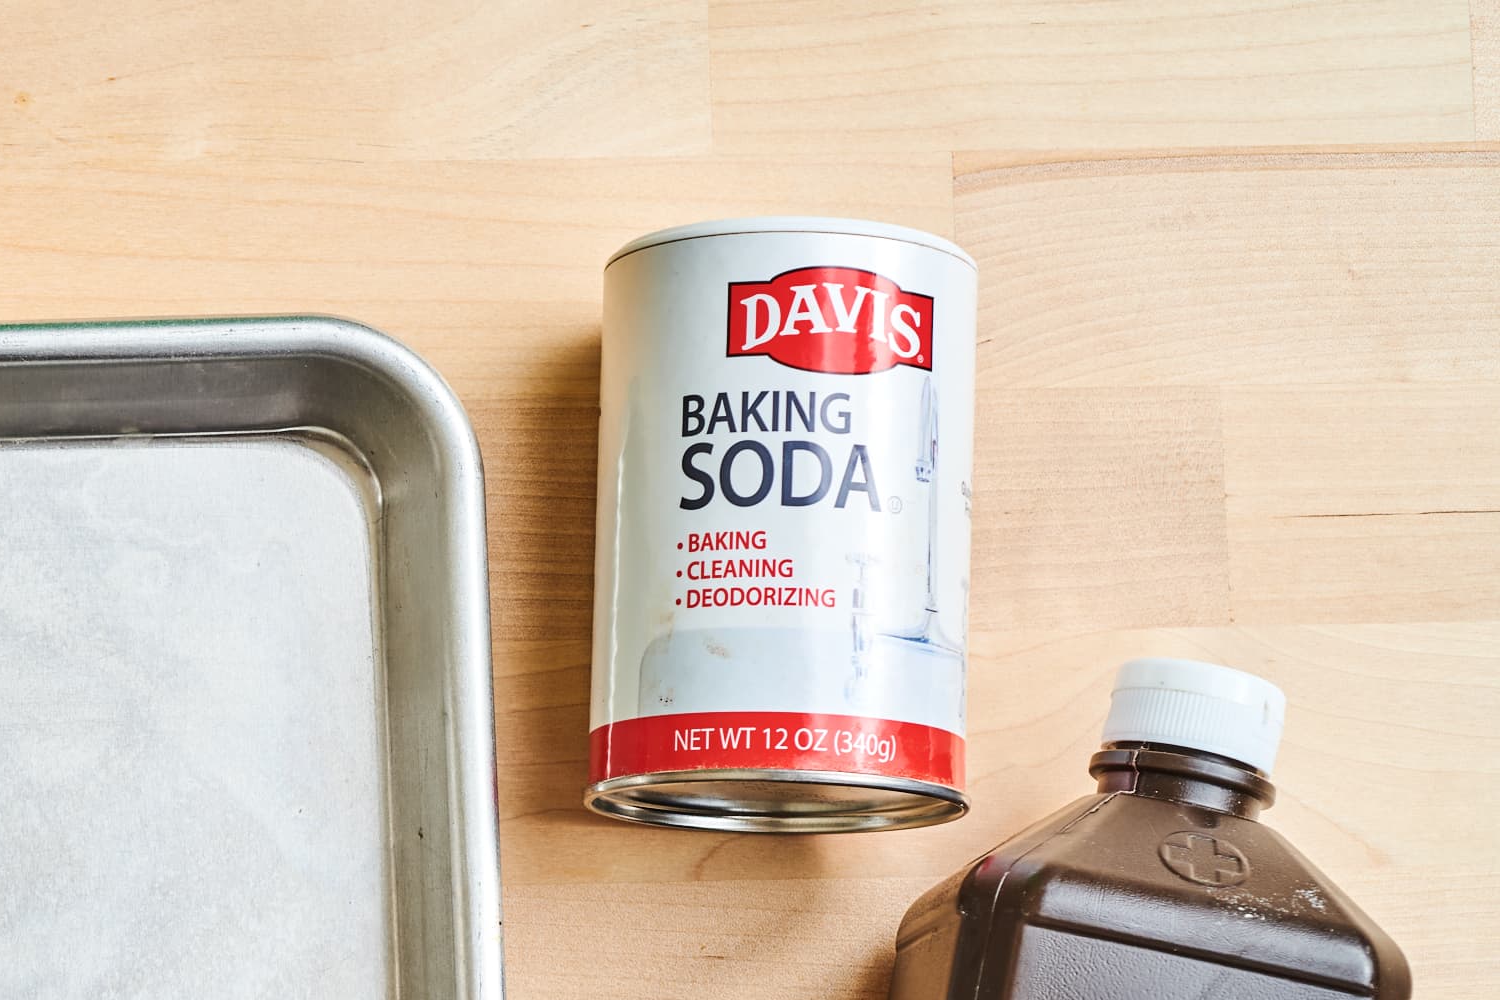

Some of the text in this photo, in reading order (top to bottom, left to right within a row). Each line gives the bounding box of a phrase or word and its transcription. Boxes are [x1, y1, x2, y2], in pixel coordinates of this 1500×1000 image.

[741, 283, 921, 359] DAVIS
[681, 390, 852, 437] BAKING
[679, 439, 882, 512] SODA
[688, 531, 767, 552] BAKING
[687, 559, 793, 581] CLEANING
[686, 587, 836, 609] DEODORIZING
[674, 727, 896, 763] NET WT 12 OZ (340g)
